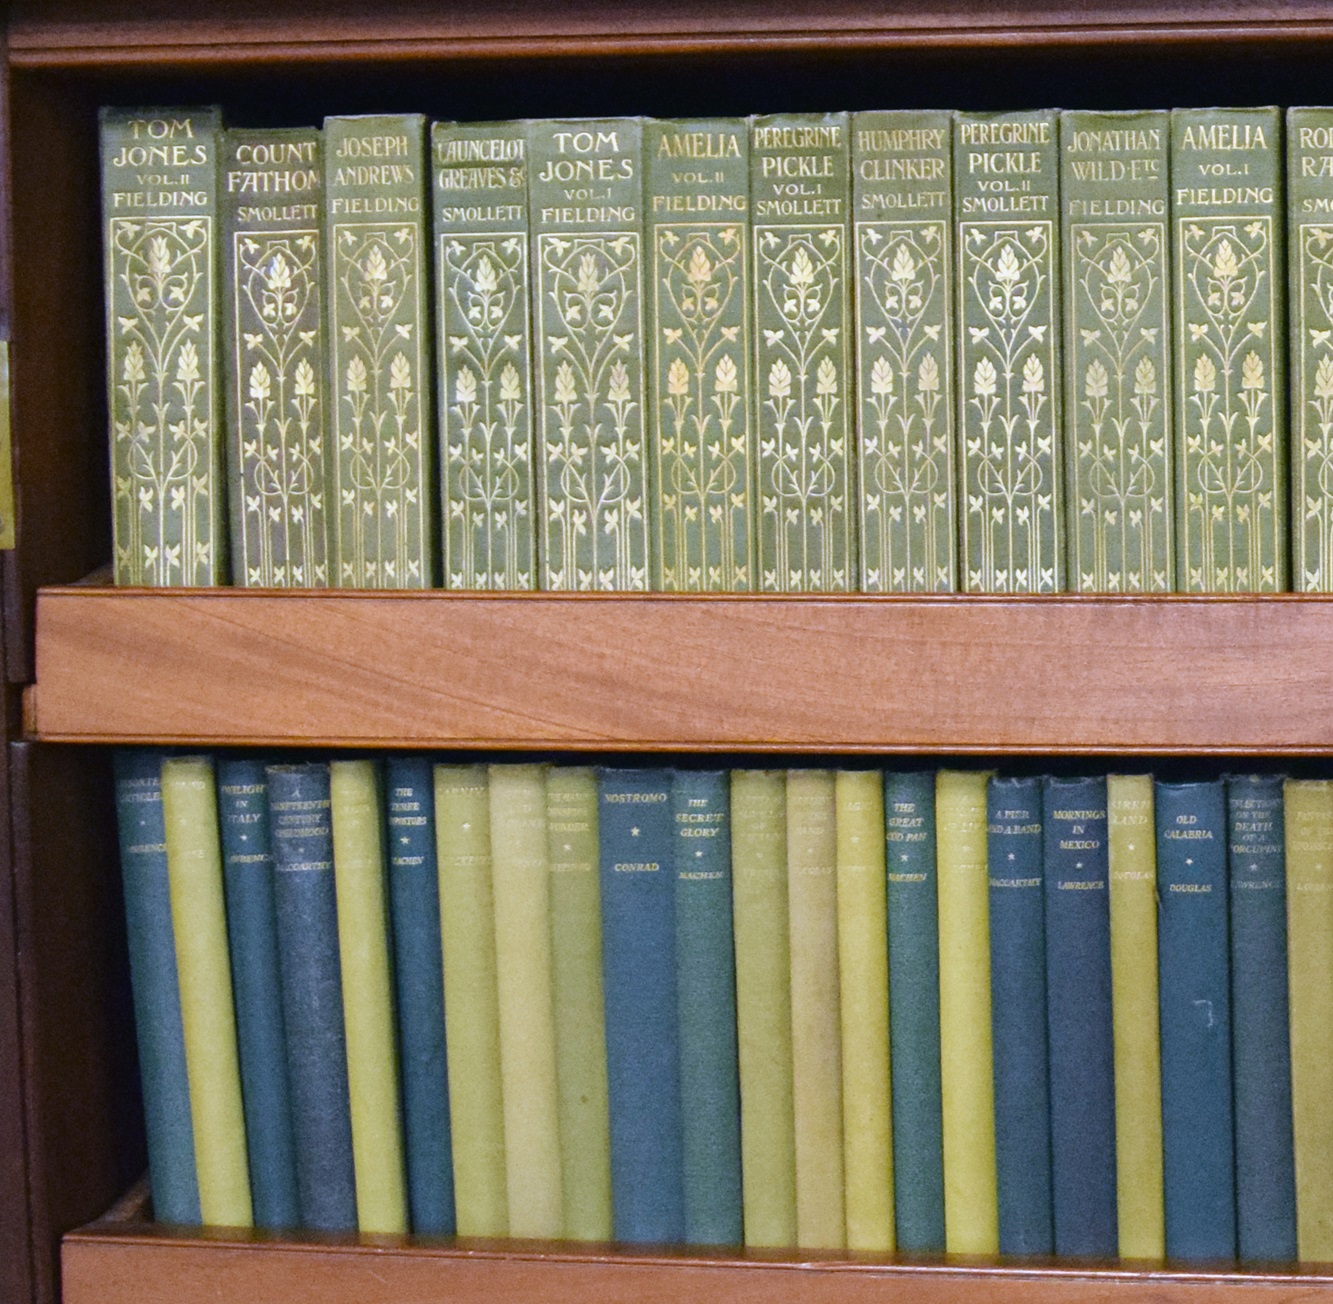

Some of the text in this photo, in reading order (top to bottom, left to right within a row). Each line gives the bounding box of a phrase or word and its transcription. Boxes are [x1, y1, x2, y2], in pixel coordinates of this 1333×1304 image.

[128, 119, 193, 140] TOM
[754, 126, 841, 149] PEREGRINE
[960, 123, 1050, 145] PEREGRINE
[1182, 125, 1267, 150] AMELIA
[336, 136, 409, 157] JOSEPH
[553, 132, 619, 153] TOM
[658, 133, 742, 159] AMELIA
[858, 129, 946, 151] HUMPHRY
[1067, 129, 1161, 153] JONATHAN
[112, 145, 208, 166] JONES
[235, 141, 317, 165] COUNT
[968, 151, 1042, 174] PICKLE
[334, 165, 415, 186] ANDREWS
[539, 159, 634, 182] JONES
[762, 155, 834, 177] PICKLE
[860, 157, 945, 181] CLINKER
[113, 191, 208, 207] FIELDING
[331, 196, 419, 213] FIELDING
[652, 194, 747, 212] FIELDING
[862, 192, 946, 210] SMOLLETT
[962, 195, 1049, 213] SMOLLETT
[1176, 187, 1274, 205] FIELDING
[237, 204, 318, 222] SMOLLETT
[442, 205, 523, 222] SMOLLETT
[541, 206, 636, 224] FIELDING
[756, 198, 841, 217] SMOLLETT
[1069, 199, 1165, 215] FIELDING
[894, 803, 915, 813] THE
[1054, 810, 1105, 819] MORNINGS
[1073, 825, 1085, 834] IN
[1176, 816, 1197, 824] OLD
[680, 827, 719, 838] GLORY
[614, 863, 659, 873] CONRAD
